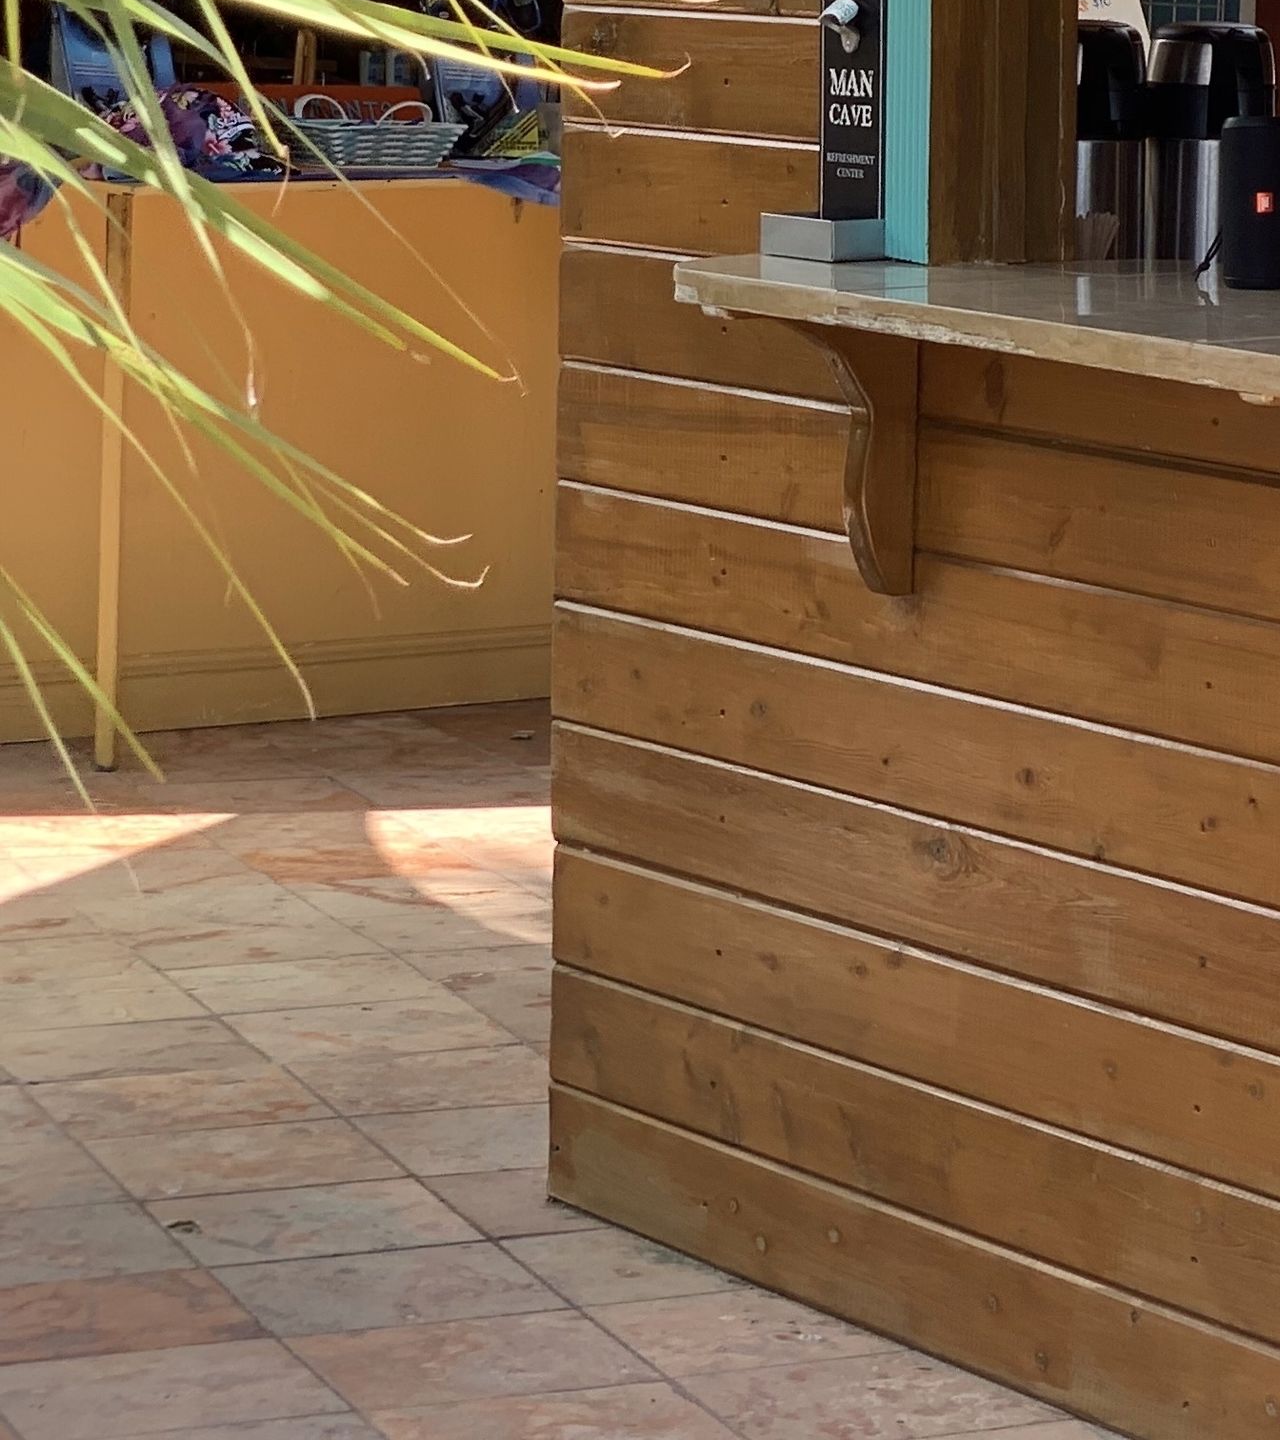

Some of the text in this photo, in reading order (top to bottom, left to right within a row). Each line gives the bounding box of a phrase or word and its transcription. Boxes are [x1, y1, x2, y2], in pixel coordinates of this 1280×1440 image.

[828, 68, 874, 99] MAN
[828, 103, 873, 128] CAVE
[827, 152, 875, 166] REFRESHMENT
[836, 167, 864, 179] CENTER
